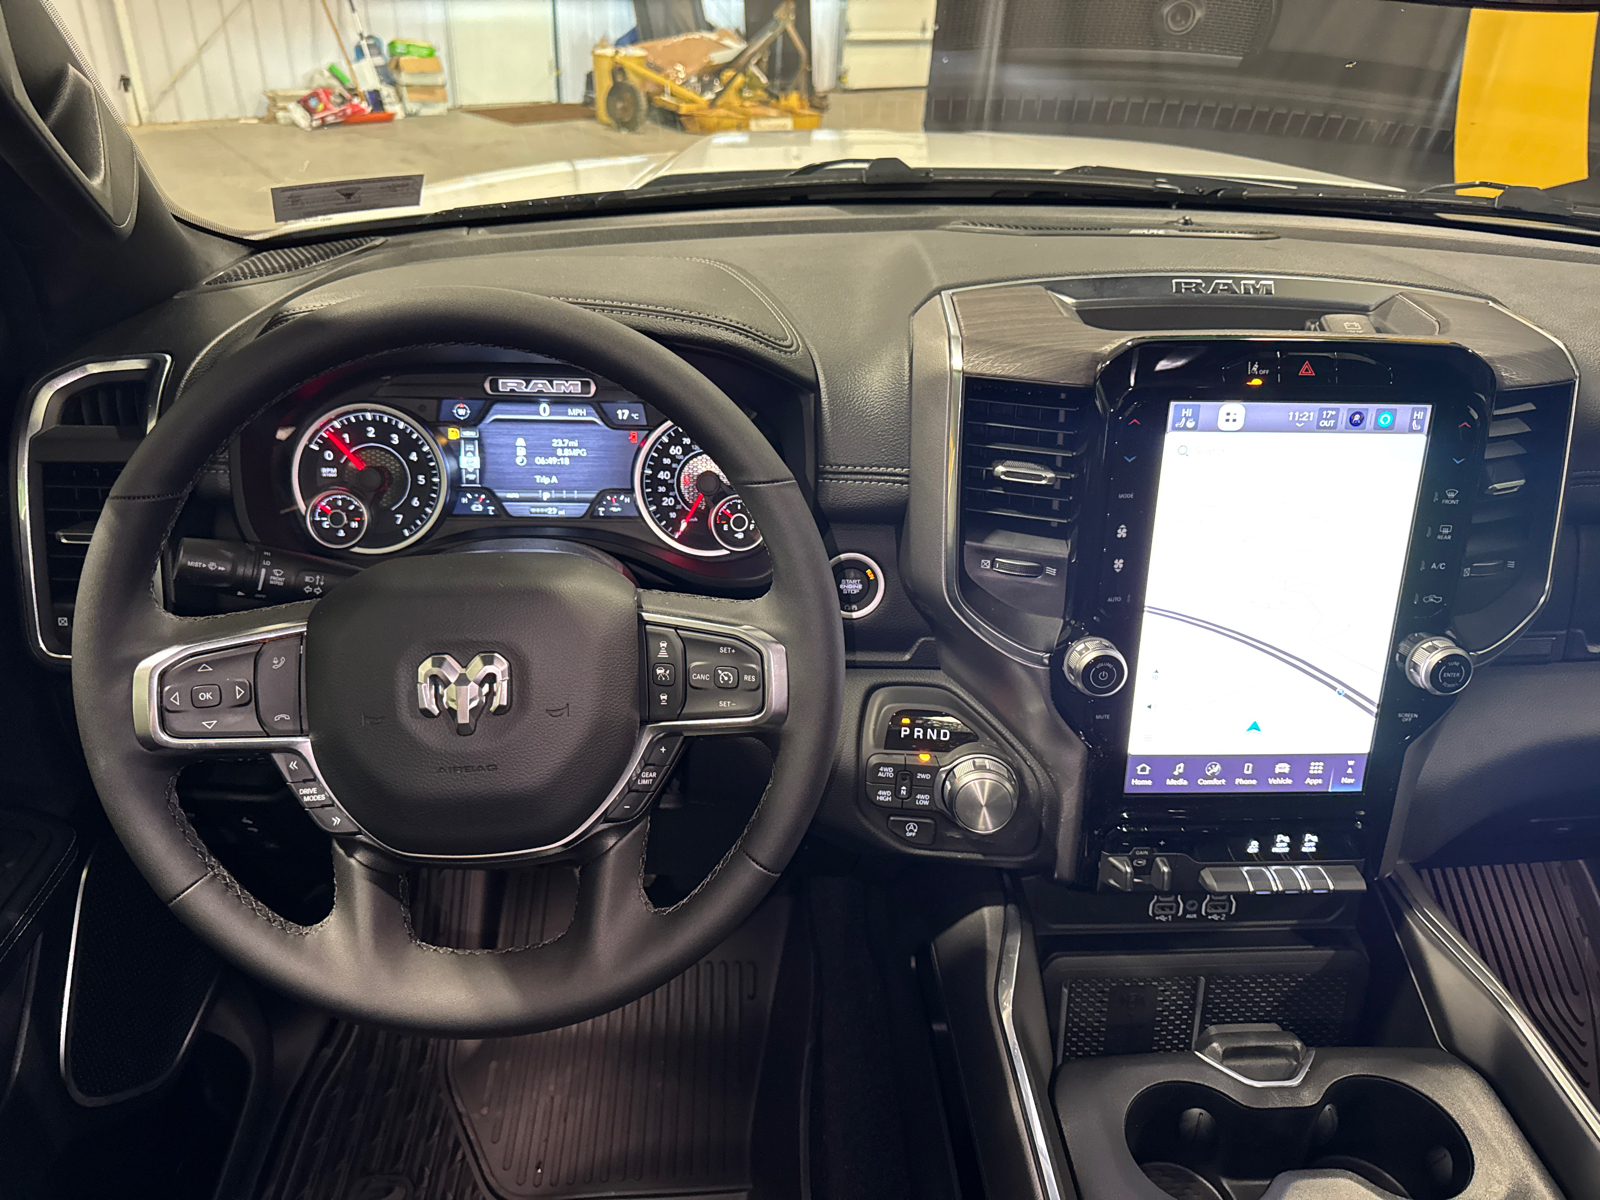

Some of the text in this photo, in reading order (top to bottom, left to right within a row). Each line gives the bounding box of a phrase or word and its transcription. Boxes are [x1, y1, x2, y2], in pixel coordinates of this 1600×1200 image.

[1172, 279, 1274, 294] RAM
[498, 379, 581, 392] RAM
[539, 403, 586, 416] 0 MPH
[616, 409, 629, 420] 17
[1182, 408, 1192, 416] HI
[1288, 411, 1314, 422] 11:21
[1413, 412, 1424, 420] HI
[1319, 419, 1336, 428] OUT
[366, 427, 376, 438] 2
[342, 433, 350, 443] 1
[390, 433, 400, 444] 3
[324, 450, 334, 461] 0
[669, 446, 682, 455] 60
[408, 452, 418, 462] 4
[417, 474, 426, 485] 5
[534, 475, 558, 484] Trip A
[658, 471, 671, 480] 40
[411, 496, 420, 507] 6
[543, 492, 550, 501] P
[662, 497, 675, 506] 20
[394, 514, 404, 524] 7
[198, 692, 213, 700] OK
[434, 764, 498, 774] AIRBAG
[1304, 777, 1323, 786] Apps
